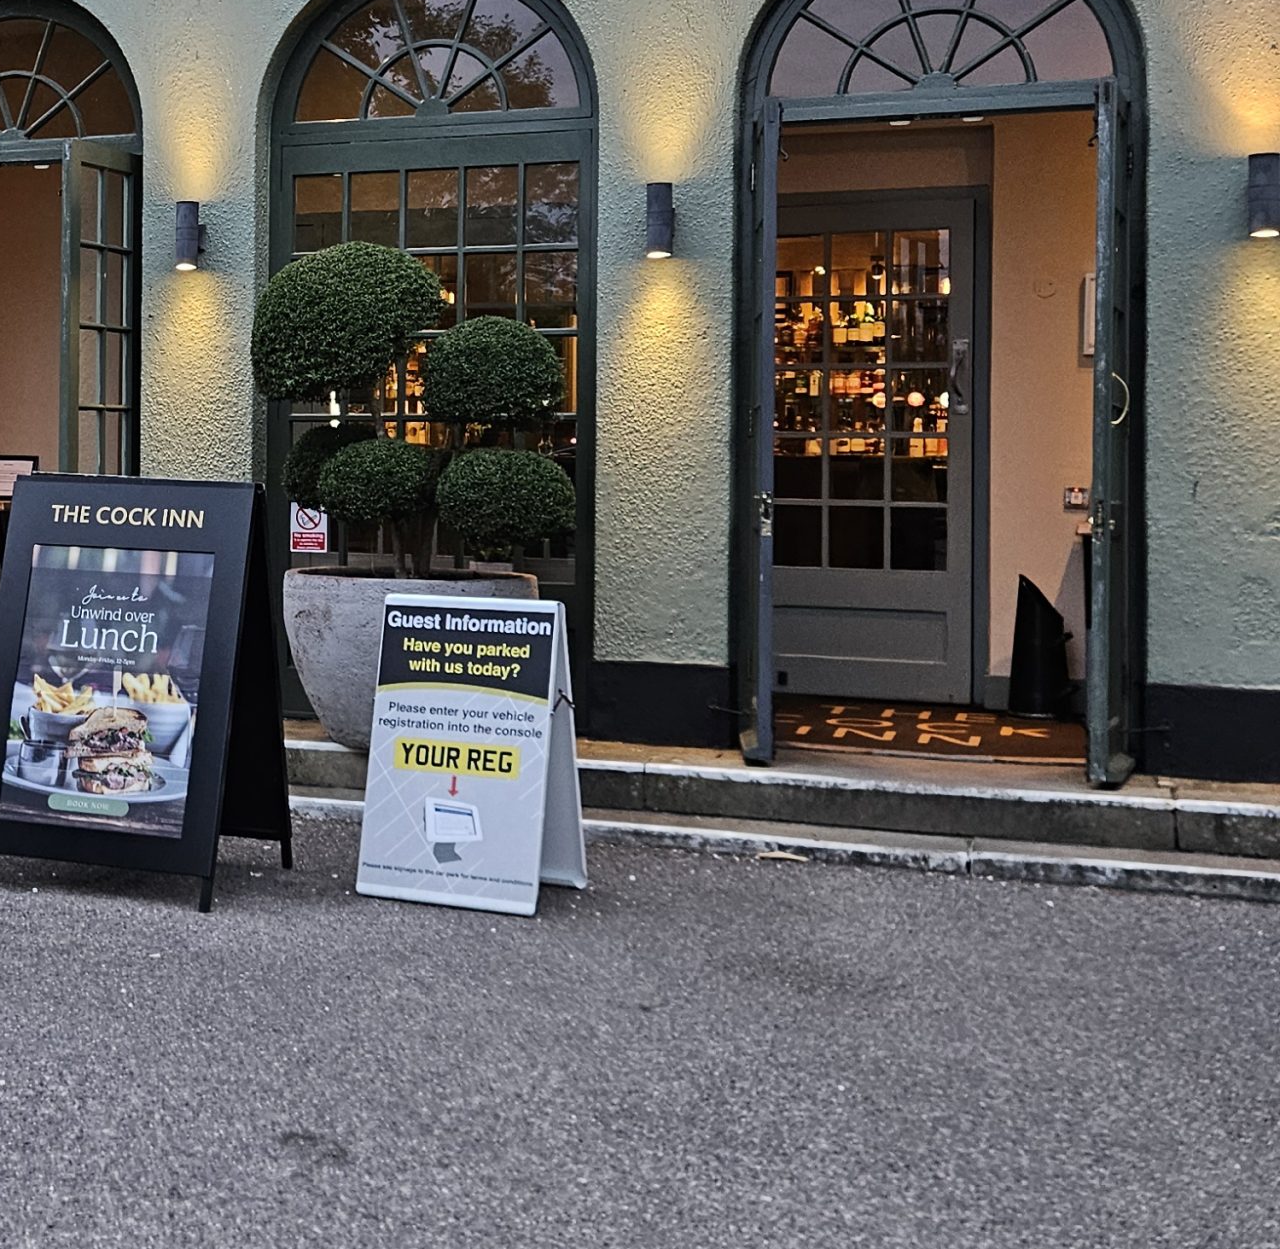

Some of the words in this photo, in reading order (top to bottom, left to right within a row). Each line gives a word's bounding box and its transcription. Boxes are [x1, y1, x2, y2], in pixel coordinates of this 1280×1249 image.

[51, 504, 91, 524] THE
[95, 506, 158, 526] COCK
[161, 508, 205, 529] INN
[71, 605, 122, 621] Unwind
[124, 611, 155, 623] over
[387, 610, 441, 630] Guest
[445, 613, 552, 636] Information
[60, 619, 158, 653] Lunch
[403, 637, 441, 653] Have
[444, 643, 472, 656] you
[476, 643, 530, 659] parked
[409, 658, 440, 673] with
[444, 663, 464, 675] us
[467, 661, 521, 680] today?
[389, 701, 427, 714] Please
[429, 705, 459, 717] enter
[462, 708, 488, 720] your
[492, 710, 535, 723] vehicle
[378, 717, 444, 731] registration
[447, 722, 469, 733] into
[473, 722, 492, 735] the
[495, 726, 543, 739] console
[795, 726, 982, 748] INN
[401, 742, 460, 769] YOUR
[467, 748, 513, 774] REG
